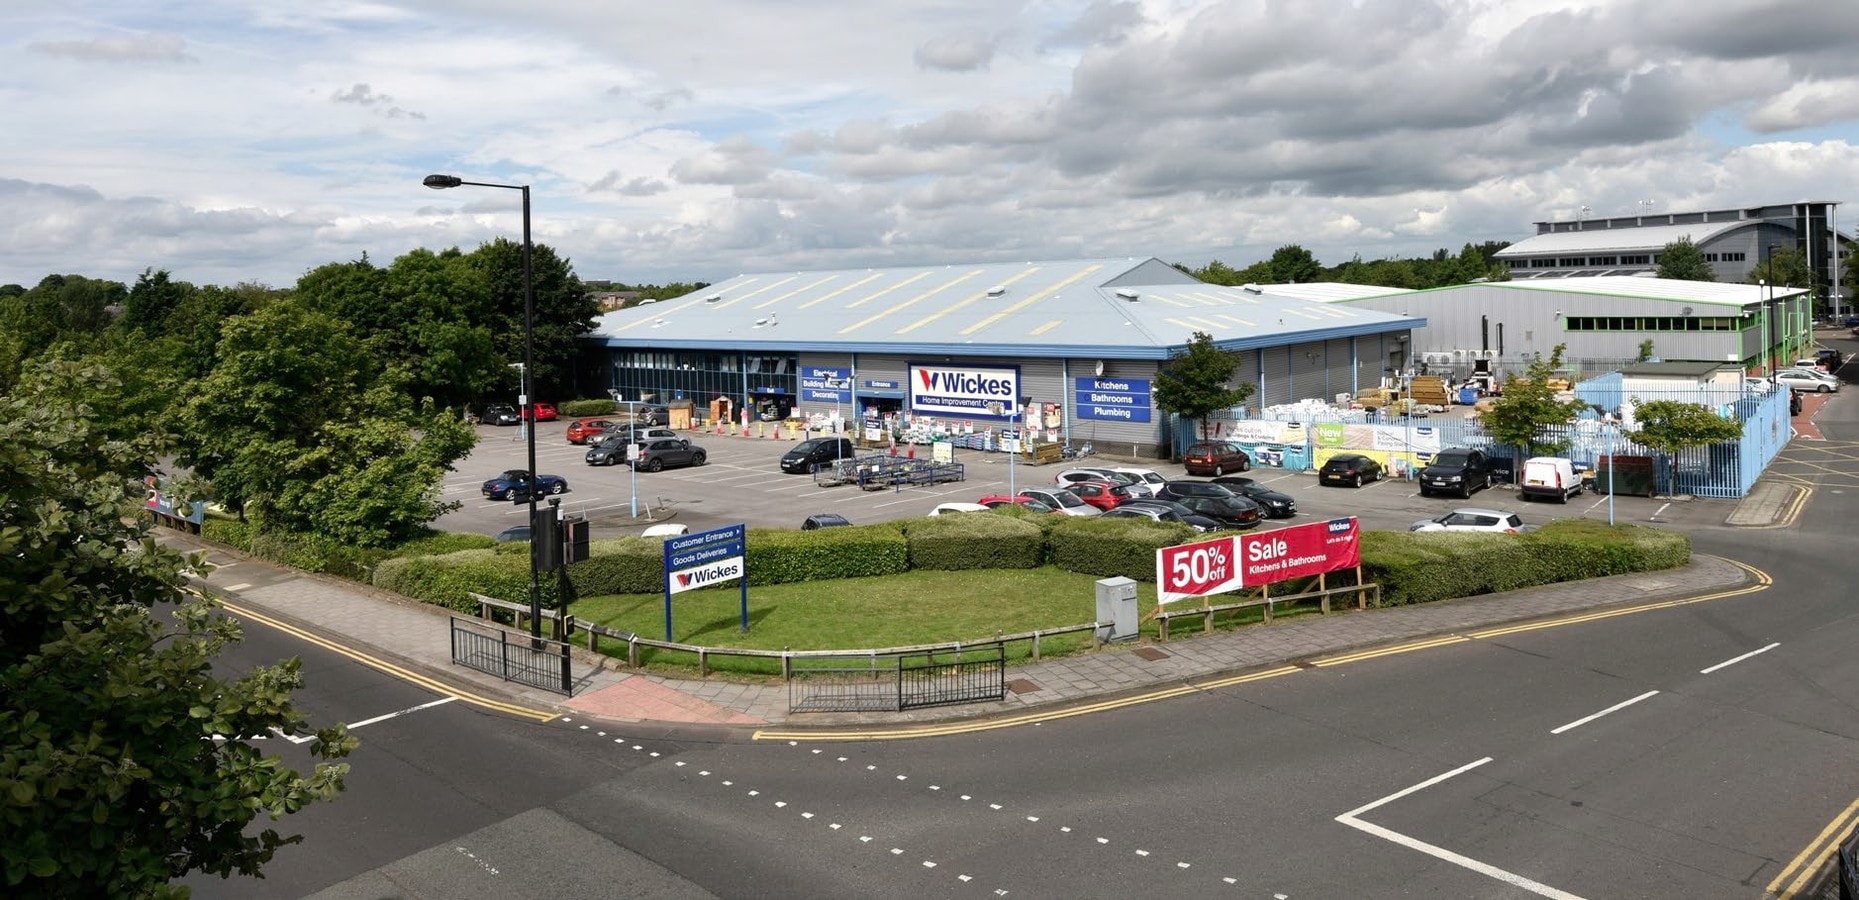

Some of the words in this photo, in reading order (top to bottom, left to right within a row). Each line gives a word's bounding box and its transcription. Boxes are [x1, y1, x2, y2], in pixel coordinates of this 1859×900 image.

[803, 380, 825, 389] Building
[871, 380, 891, 388] Entrance
[941, 372, 1012, 396] Wickes
[1094, 381, 1129, 390] Kitchens
[922, 396, 940, 404] Home
[941, 396, 981, 407] Improvement
[1091, 393, 1133, 404] Bathrooms
[1094, 406, 1131, 419] Plumbing
[1319, 426, 1341, 438] New
[672, 536, 704, 550] Customer
[705, 530, 734, 542] Entrance
[673, 555, 696, 566] Goods
[696, 547, 728, 560] Deliveries
[1249, 537, 1287, 562] Sale
[1172, 545, 1226, 588] 50%
[1249, 562, 1280, 575] Kitchens
[1281, 560, 1288, 569] &
[1288, 553, 1327, 567] Bathrooms
[694, 564, 738, 584] Wickes
[1209, 566, 1226, 582] off
